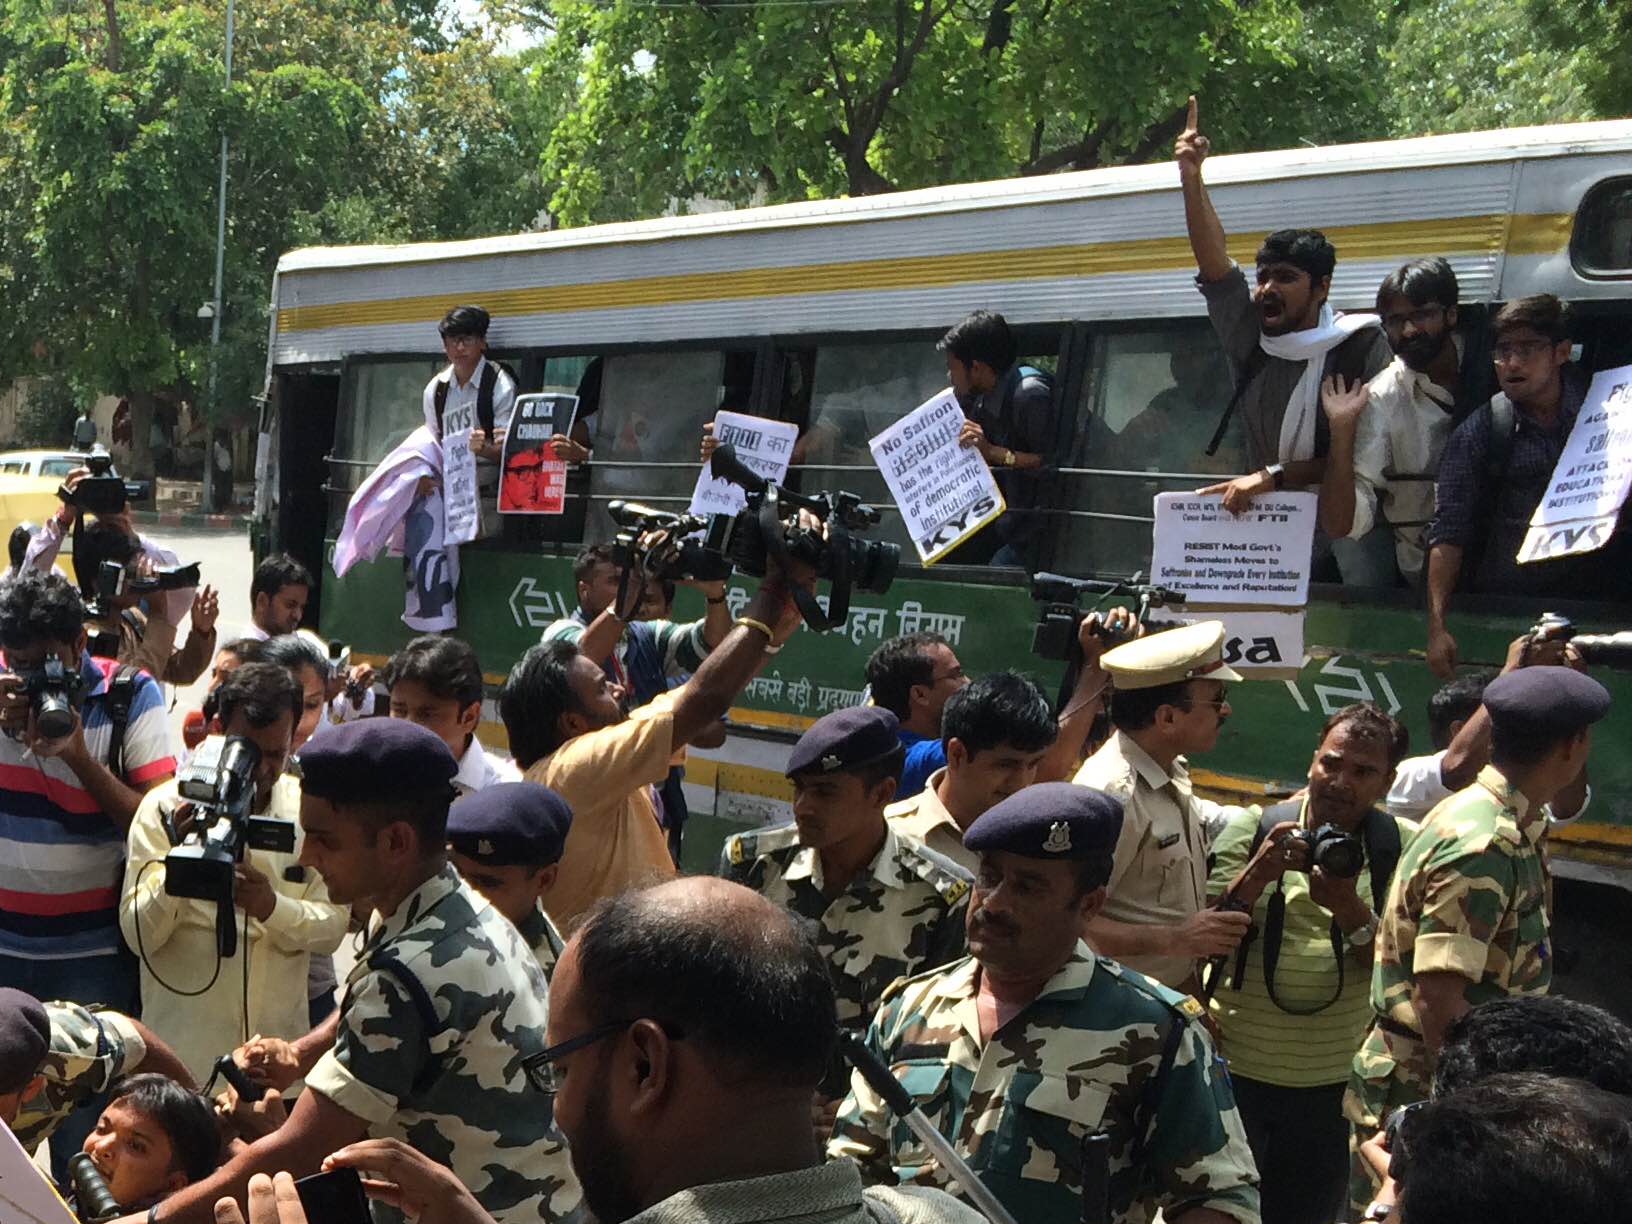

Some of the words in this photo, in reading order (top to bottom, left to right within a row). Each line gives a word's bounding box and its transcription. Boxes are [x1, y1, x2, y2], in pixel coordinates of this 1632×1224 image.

[447, 408, 471, 434] KYS
[767, 435, 790, 454] का
[881, 442, 902, 456] No
[899, 476, 917, 492] has
[919, 464, 933, 480] the
[935, 449, 956, 470] right
[925, 464, 982, 506] democratic
[922, 496, 995, 554] KYS
[1184, 542, 1219, 550] RESIST
[1222, 543, 1247, 551] Modi
[1184, 555, 1232, 564] Shameless
[1234, 556, 1265, 564] Moves
[1223, 637, 1283, 663] sa
